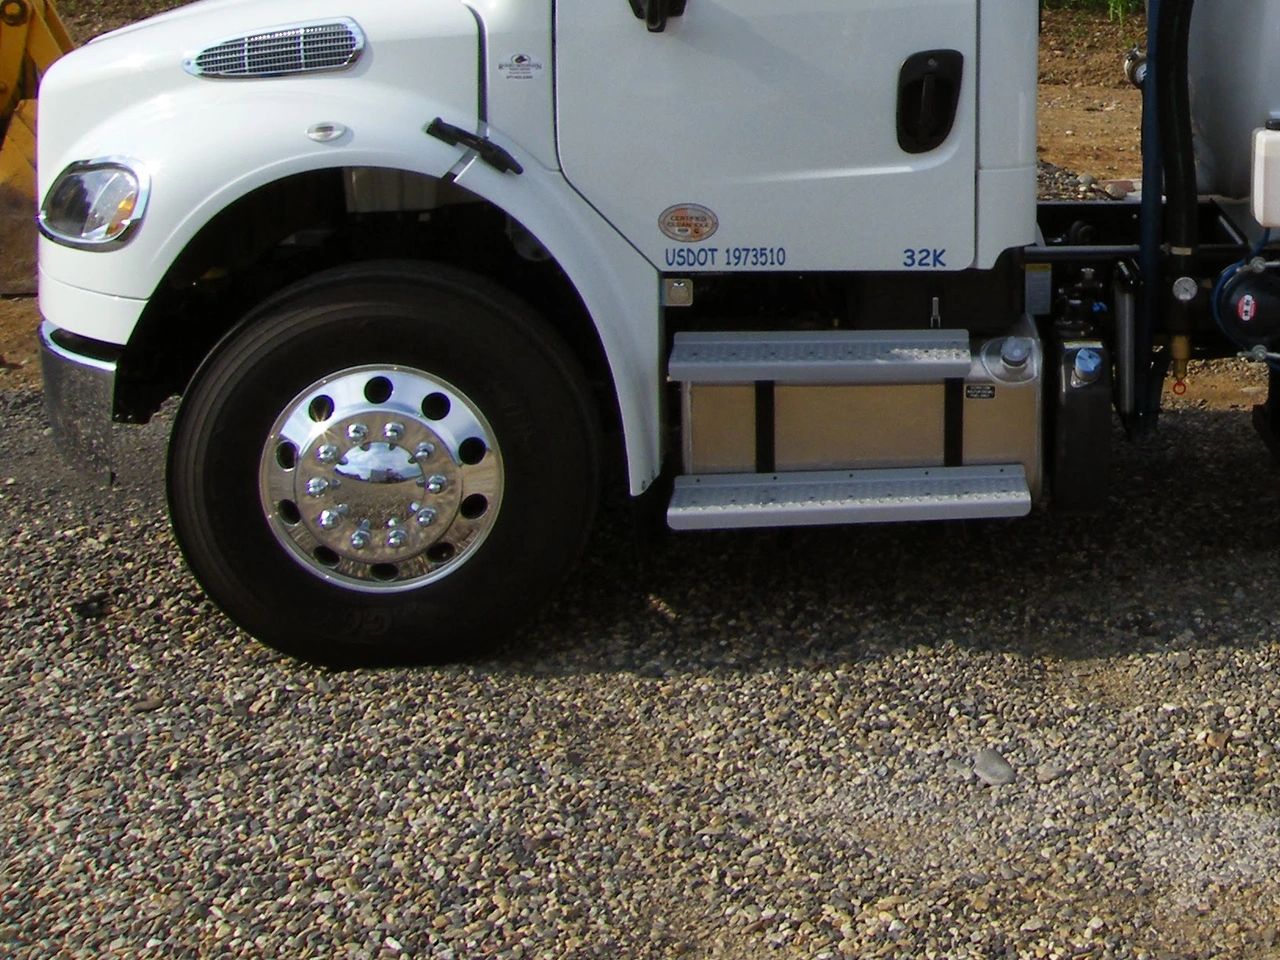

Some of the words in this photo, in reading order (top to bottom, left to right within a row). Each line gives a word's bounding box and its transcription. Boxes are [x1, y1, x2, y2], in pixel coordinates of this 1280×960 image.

[665, 247, 718, 267] USDOT
[725, 247, 786, 267] 1973510
[903, 248, 947, 268] 32K
